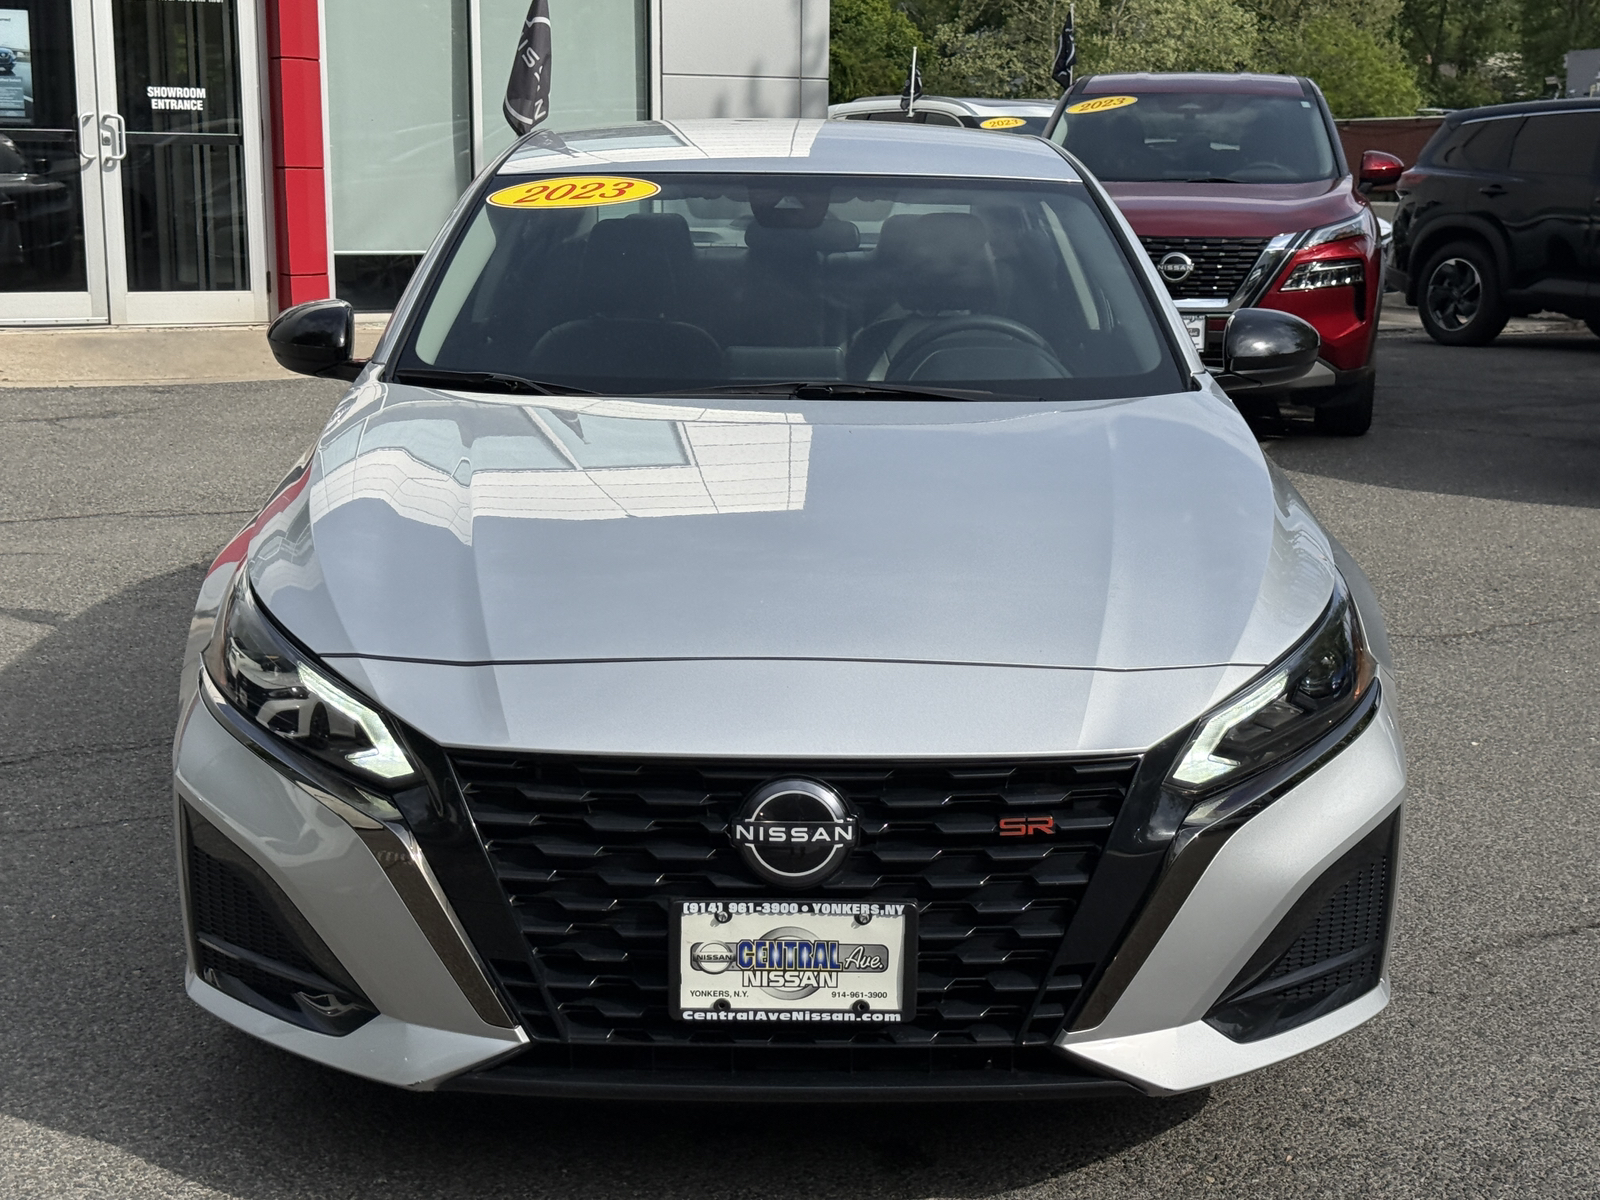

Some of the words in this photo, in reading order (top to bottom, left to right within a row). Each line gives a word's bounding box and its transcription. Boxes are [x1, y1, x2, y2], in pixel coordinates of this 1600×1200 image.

[147, 86, 206, 98] SHOWROOM
[151, 98, 204, 110] ENTRANCE
[1079, 97, 1126, 112] 2023
[989, 119, 1019, 128] 2023
[513, 182, 635, 204] 2023
[1000, 817, 1054, 835] SR
[736, 824, 853, 842] NISSAN
[728, 903, 799, 914] 961-3900
[737, 939, 843, 971] CENTRAL
[844, 945, 884, 969] Ave.
[742, 970, 838, 988] NISSAN
[690, 990, 732, 998] YONKERS,
[831, 991, 888, 999] 914-961-3900
[682, 1010, 901, 1021] CentralAveNissan.com
